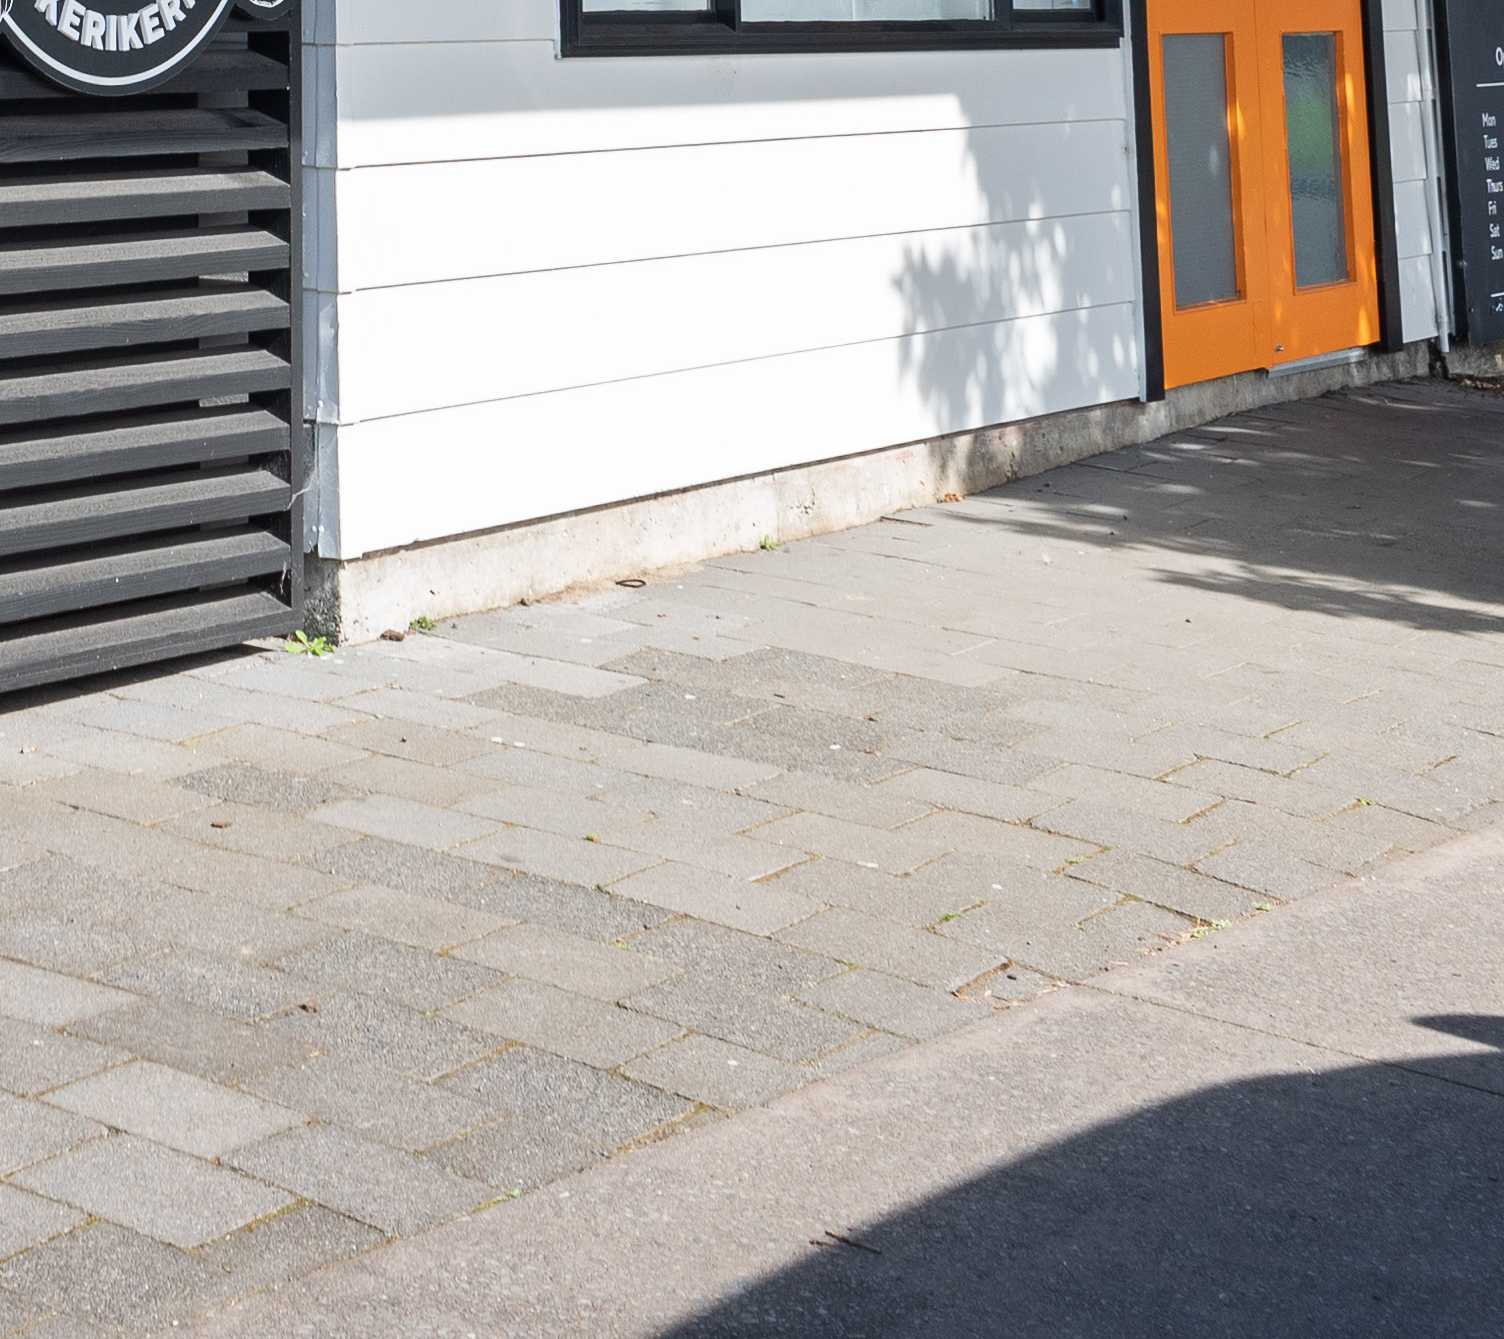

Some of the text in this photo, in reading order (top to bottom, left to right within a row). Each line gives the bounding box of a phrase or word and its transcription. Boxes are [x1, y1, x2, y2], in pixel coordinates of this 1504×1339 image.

[1482, 112, 1497, 127] Mon
[1483, 134, 1498, 149] Tues
[1485, 156, 1500, 171] Wed
[1486, 178, 1503, 193] Thurs
[1488, 200, 1497, 216] Fri
[1490, 223, 1500, 238] Sat
[1491, 245, 1503, 260] Sun
